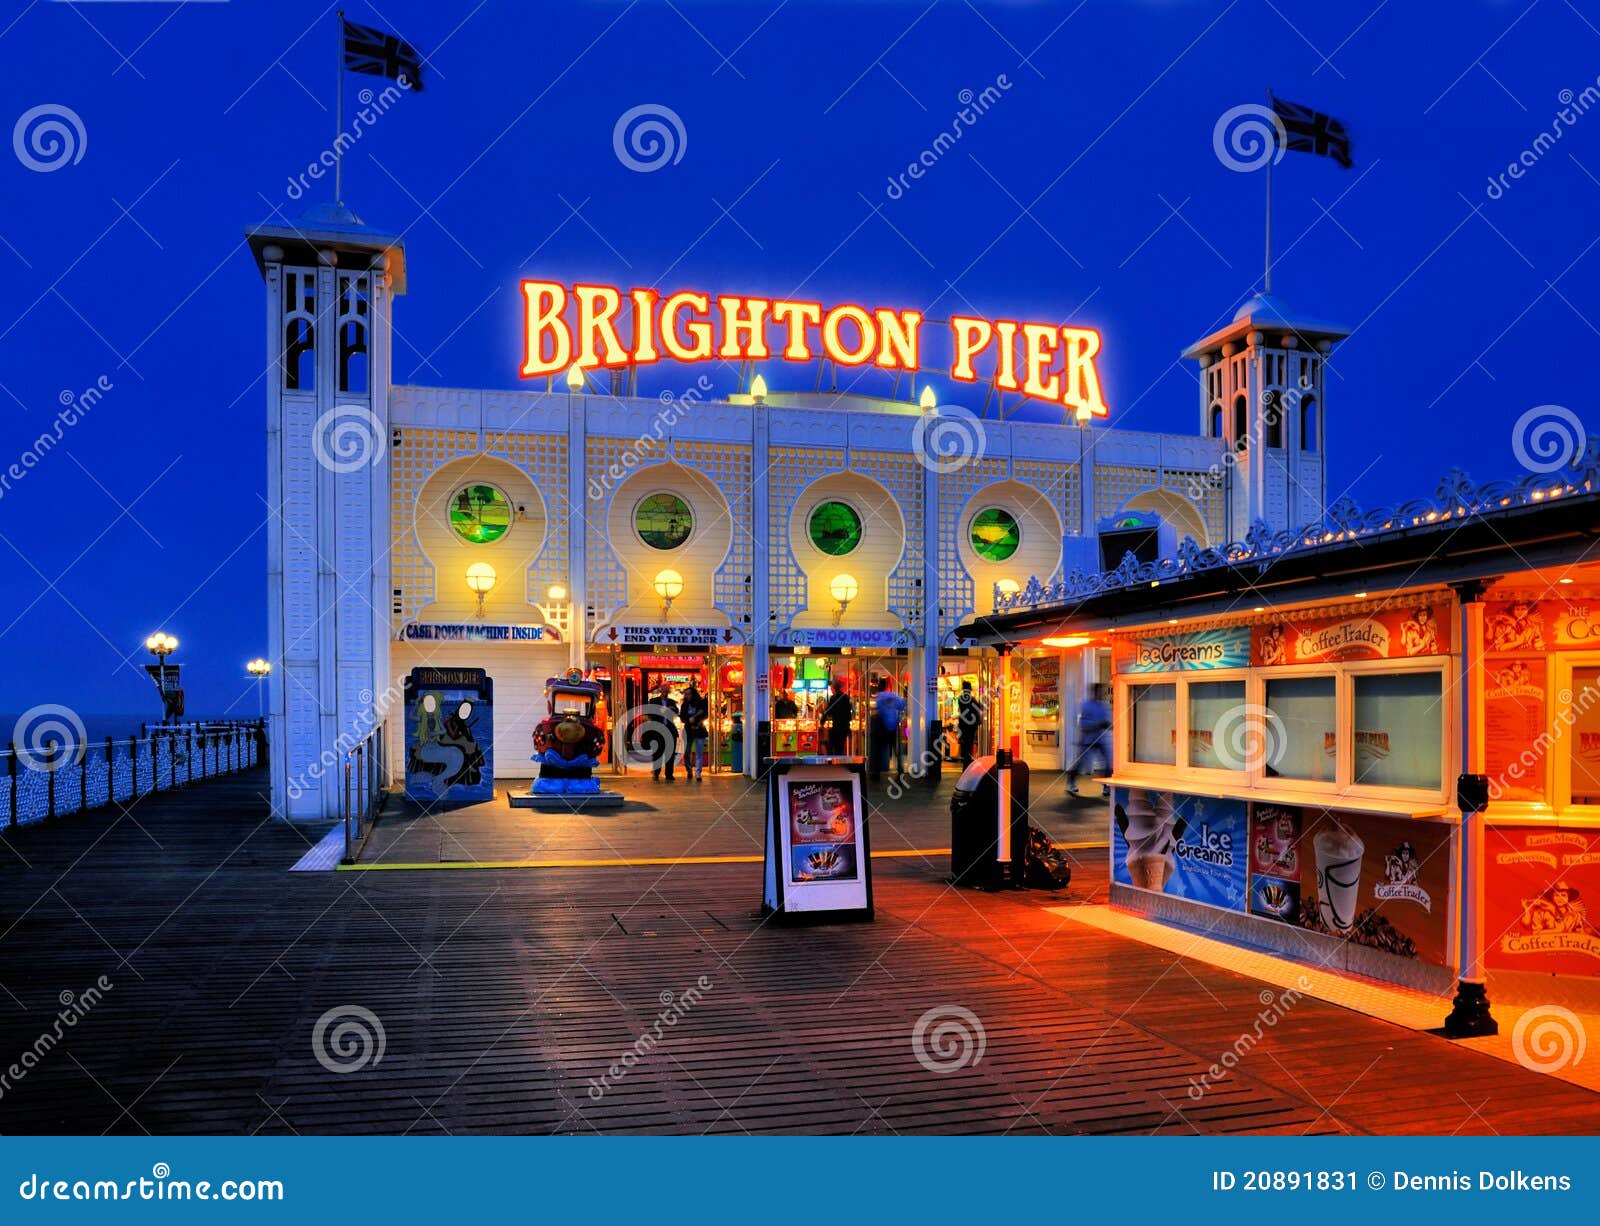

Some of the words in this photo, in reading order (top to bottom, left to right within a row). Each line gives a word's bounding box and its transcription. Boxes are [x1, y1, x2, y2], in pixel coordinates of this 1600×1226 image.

[519, 279, 922, 378] BRIGHTON
[951, 315, 1109, 416] PIER
[1568, 606, 1590, 616] THE
[406, 624, 432, 639] CASH
[434, 624, 464, 640] POINT
[466, 624, 509, 640] MACHINE
[512, 626, 543, 640] INSIDE
[624, 626, 650, 634] THIS
[653, 627, 677, 635] WAY
[679, 627, 694, 635] TO
[697, 628, 718, 636] THE
[816, 629, 847, 641] MOO
[851, 630, 893, 642] MOO'S
[624, 635, 646, 643] END
[649, 635, 664, 643] OF
[693, 636, 718, 644] PIER
[1301, 630, 1341, 656] Coffee
[1339, 624, 1387, 648] Trader
[1202, 824, 1233, 849] Ice
[1175, 839, 1233, 867] Creams
[1378, 887, 1402, 898] Coffee
[1402, 886, 1429, 905] Trader
[1508, 937, 1555, 952] Coffee
